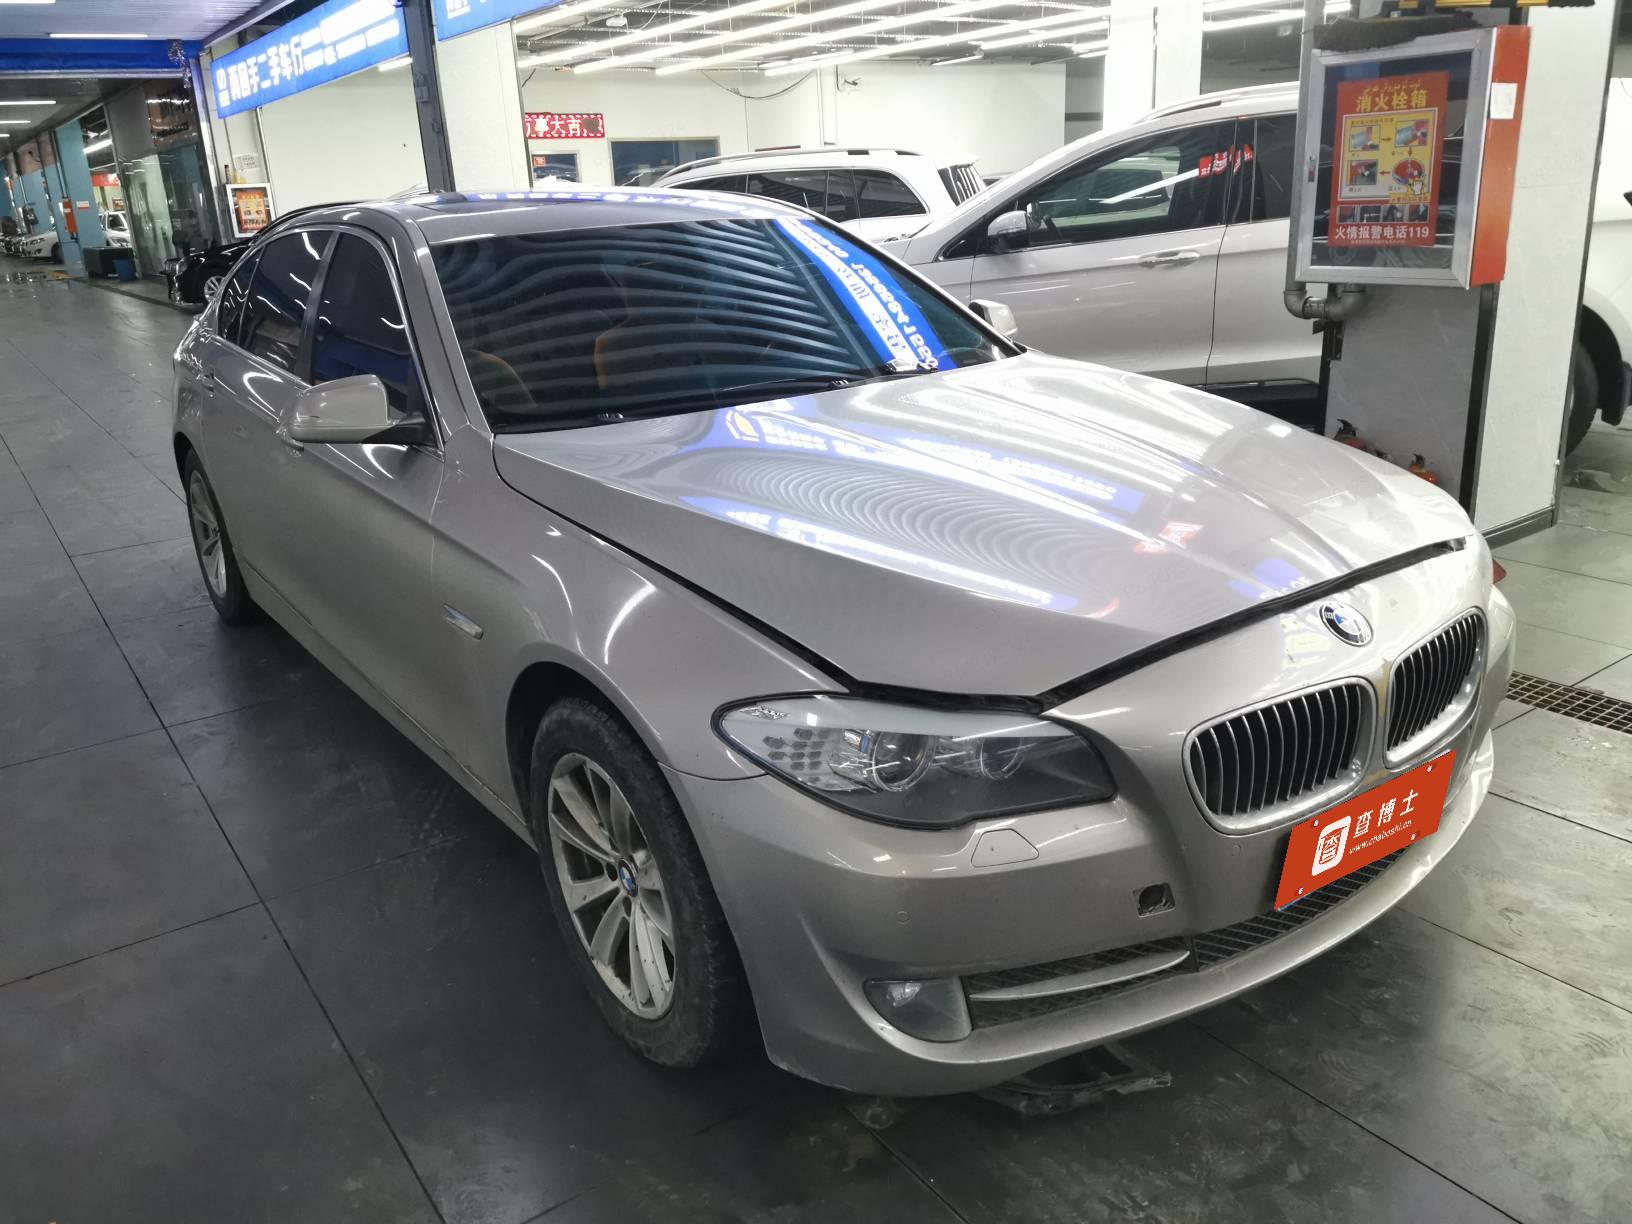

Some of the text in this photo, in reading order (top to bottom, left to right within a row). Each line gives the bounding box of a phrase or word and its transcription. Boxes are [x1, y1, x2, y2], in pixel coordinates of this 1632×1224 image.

[1355, 89, 1428, 113] 消火栓箱
[1335, 225, 1429, 240] 火情报警电话119
